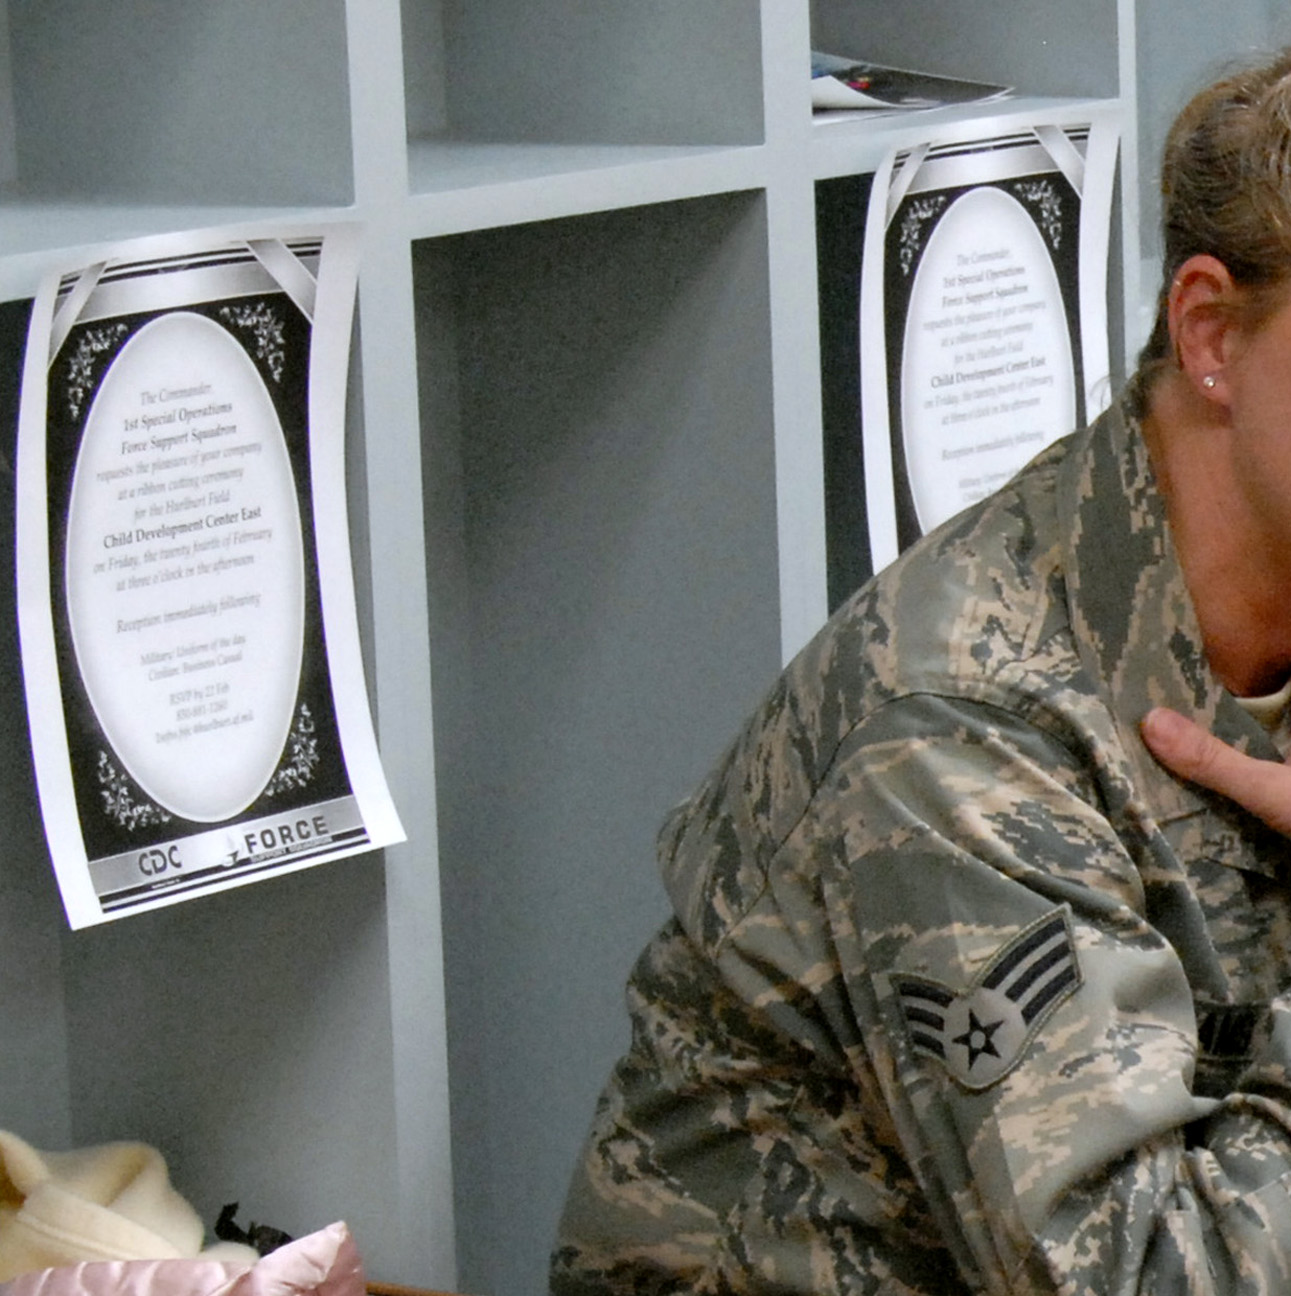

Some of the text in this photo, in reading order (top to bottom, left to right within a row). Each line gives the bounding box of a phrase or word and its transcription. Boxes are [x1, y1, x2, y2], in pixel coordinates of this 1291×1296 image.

[141, 411, 176, 431] Special
[178, 403, 233, 425] Operations
[121, 422, 238, 455] Force Support Squadron
[103, 505, 263, 549] Child Development Center East
[138, 844, 183, 877] CDC
[243, 814, 330, 855] FORCE
